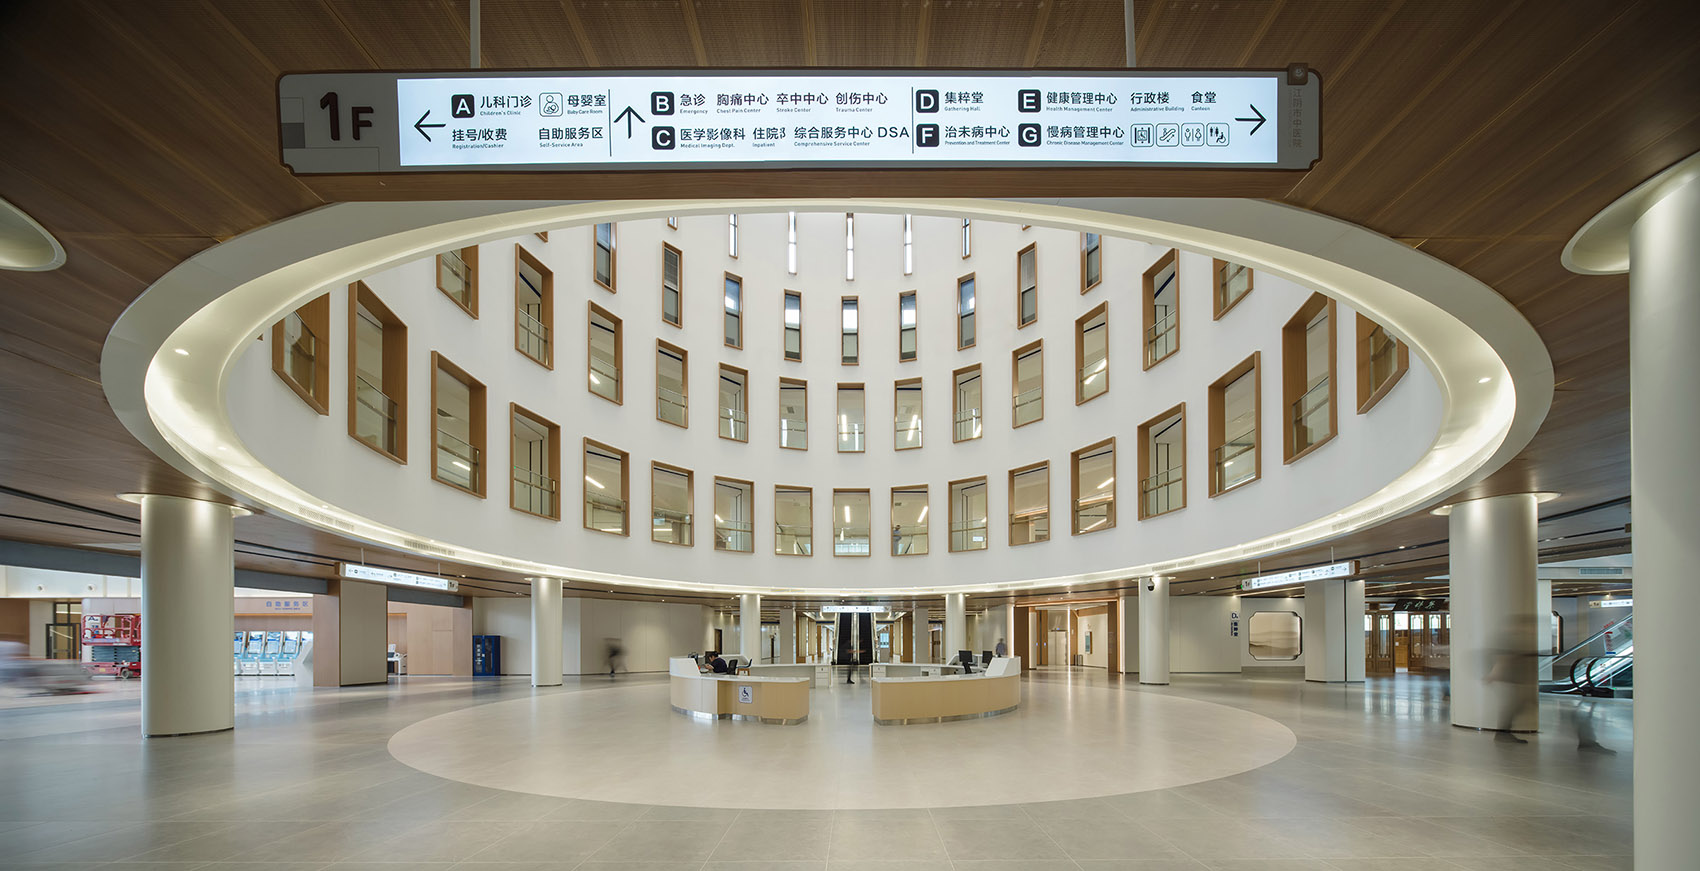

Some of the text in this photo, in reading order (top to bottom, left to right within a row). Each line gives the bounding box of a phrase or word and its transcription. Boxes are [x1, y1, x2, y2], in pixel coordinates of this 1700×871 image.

[456, 95, 533, 114] A 儿科门诊
[567, 94, 607, 107] 母婴室
[656, 92, 888, 112] B 急诊 胸痛中心 卒中中心 创伤中心
[920, 91, 984, 110] D 集粹堂
[1023, 91, 1118, 109] E 健康管理中心
[1130, 91, 1170, 105] 行政楼
[1191, 91, 1217, 104] 食堂
[320, 92, 374, 141] 1F
[452, 128, 507, 142] 挂号/收费
[539, 126, 604, 141] 自助服务区
[656, 129, 671, 146] C
[680, 127, 746, 142] 医学影像科
[794, 126, 873, 140] 综合服务中心
[878, 127, 910, 140] DSA
[921, 125, 1011, 144] F 治未病中心
[1022, 125, 1125, 144] G 慢病管理中心
